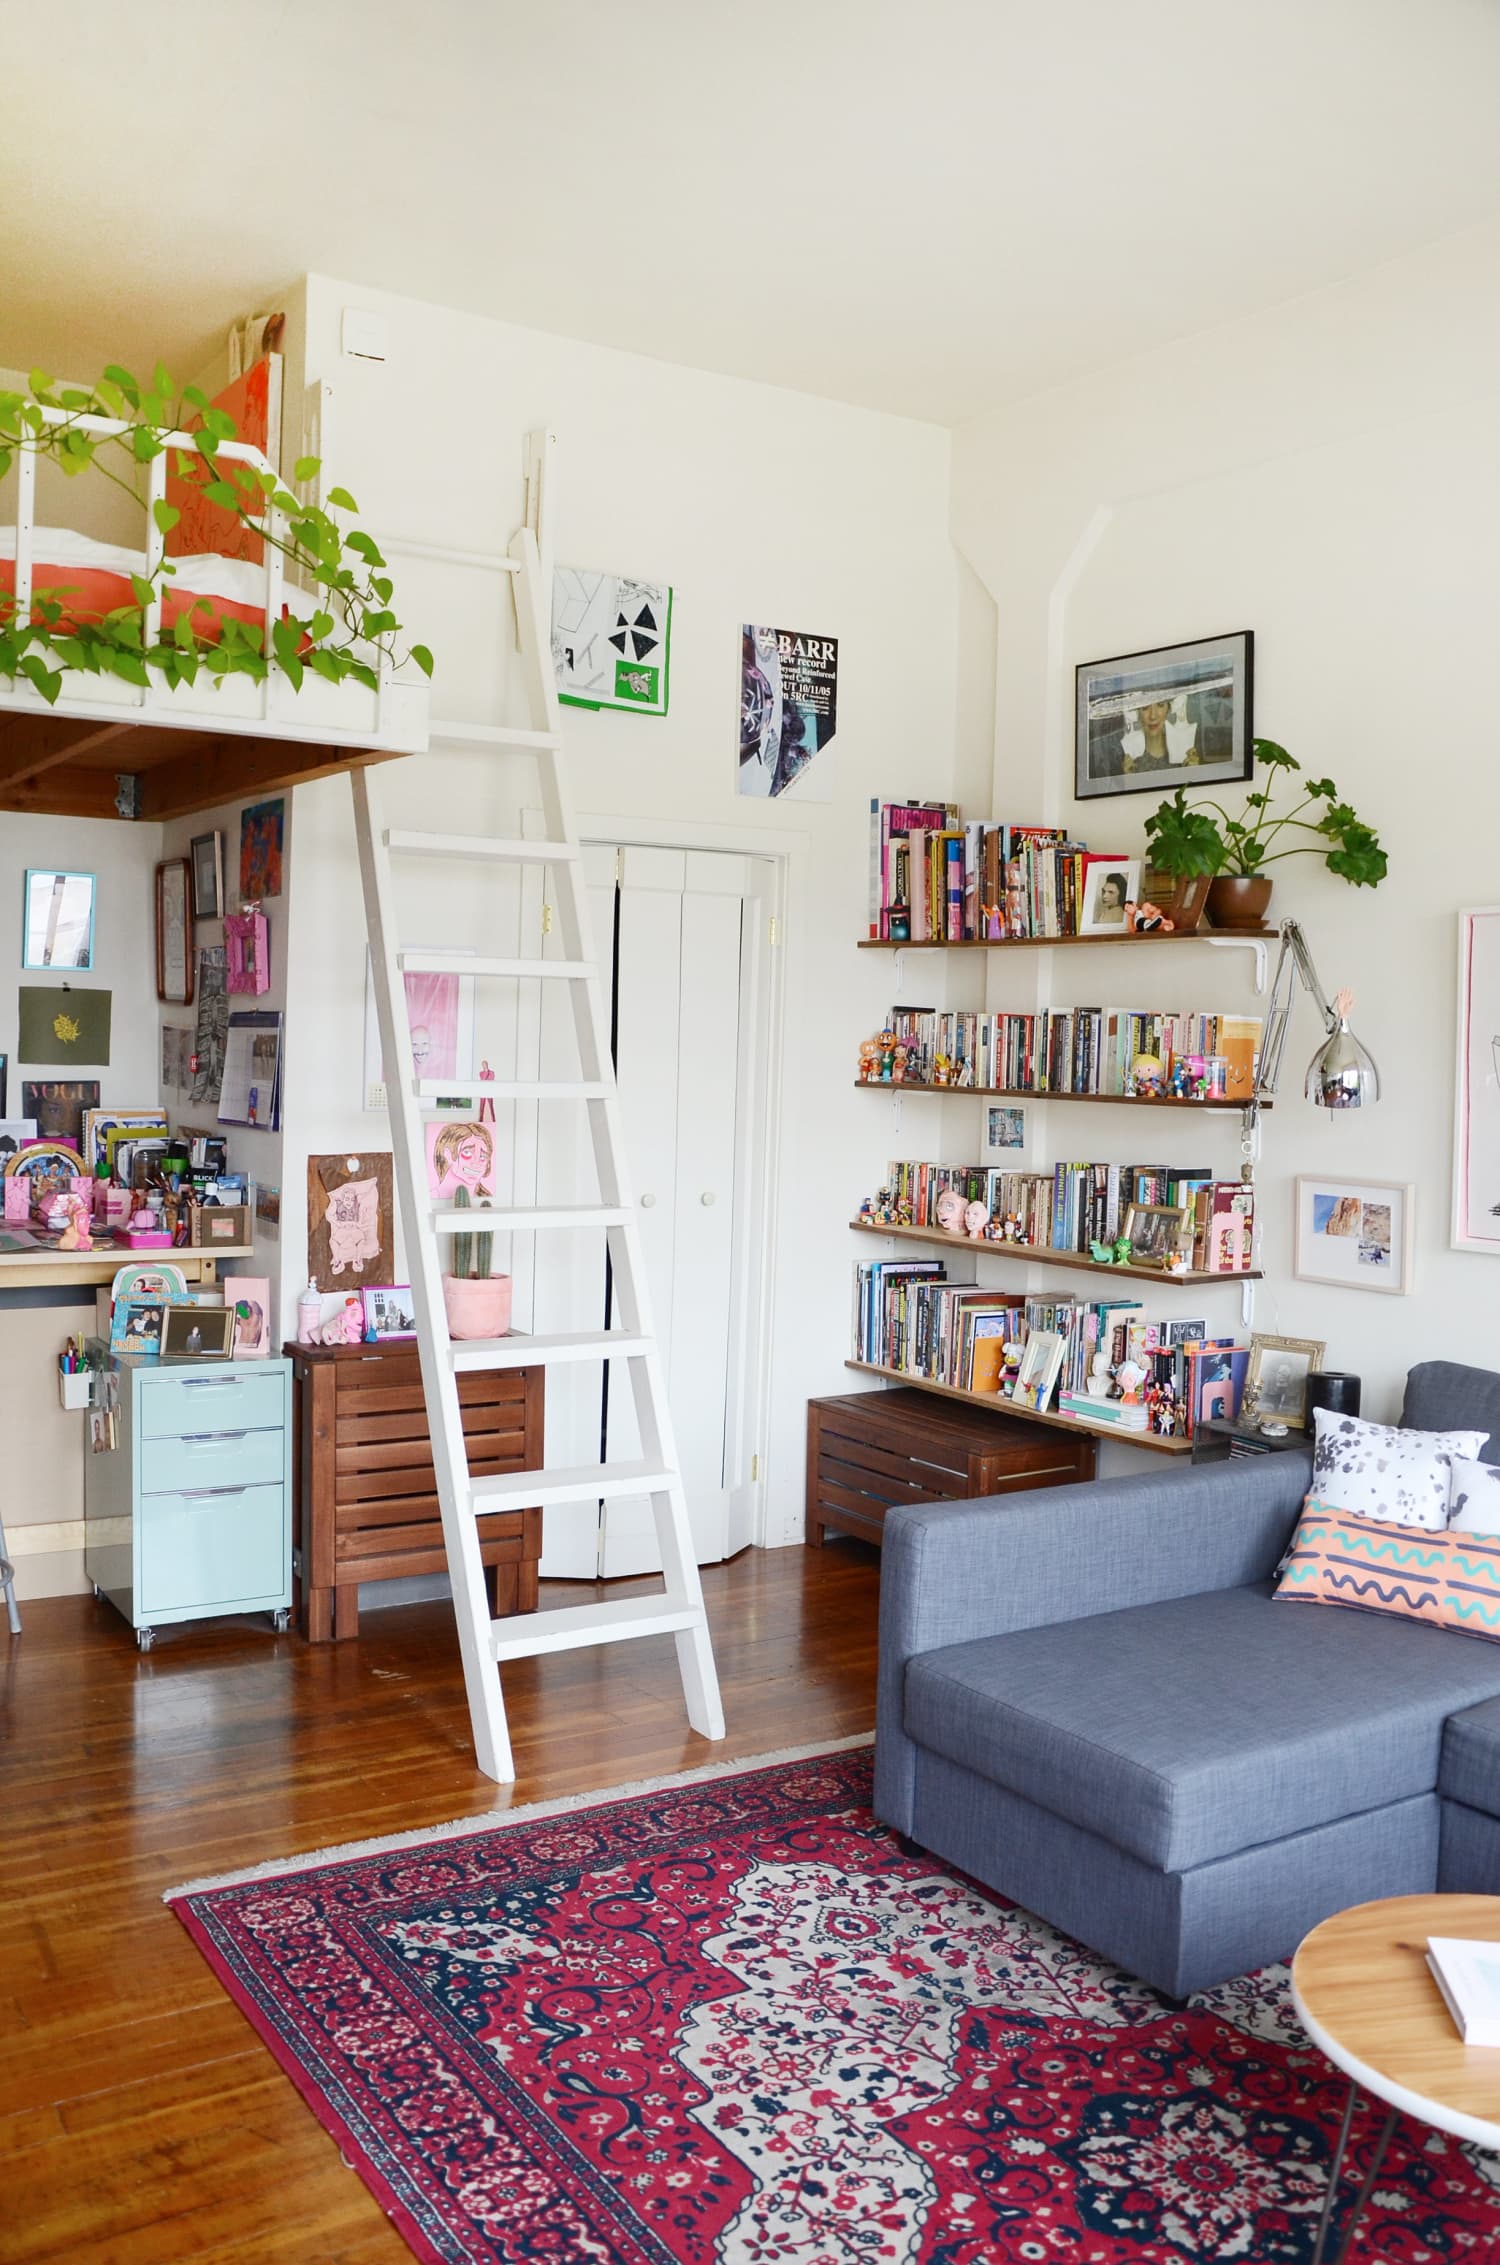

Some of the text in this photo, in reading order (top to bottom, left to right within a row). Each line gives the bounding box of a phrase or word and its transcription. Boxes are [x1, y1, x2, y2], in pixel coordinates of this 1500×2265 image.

[778, 635, 835, 662] BARR
[797, 657, 827, 669] record
[780, 665, 800, 674] eyond
[799, 683, 831, 696] 10/11/05
[790, 691, 809, 702] 5RC
[1057, 1164, 1065, 1200] INFINITE
